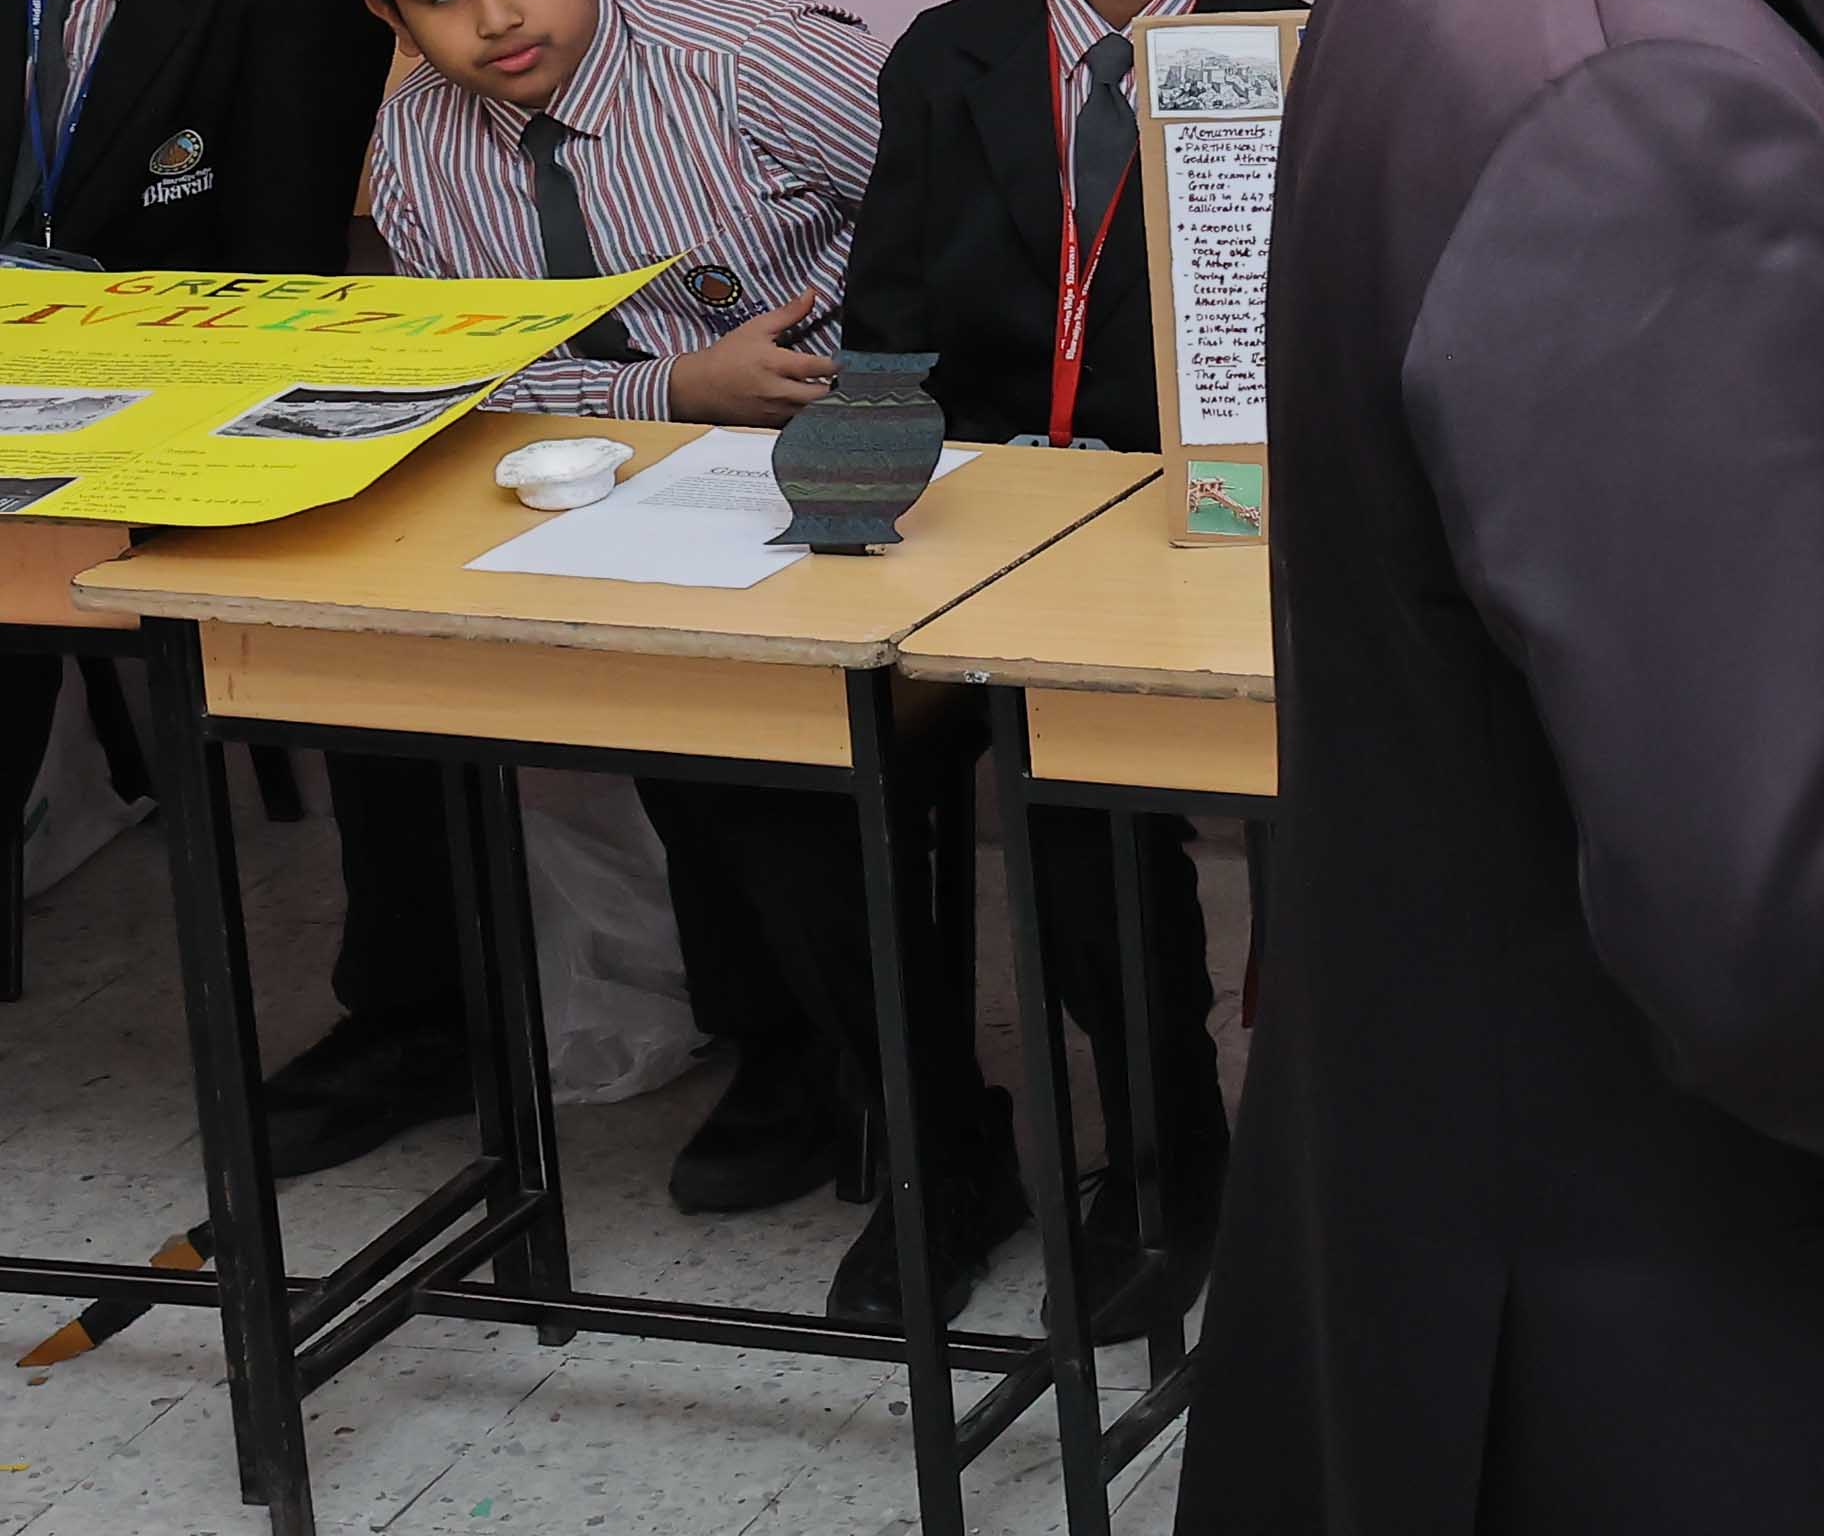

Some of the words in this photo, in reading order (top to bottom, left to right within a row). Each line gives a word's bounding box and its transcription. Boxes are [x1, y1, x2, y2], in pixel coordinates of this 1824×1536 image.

[1218, 172, 1260, 181] example
[103, 275, 376, 302] GREEK
[0, 297, 612, 336] IVILIZATIO
